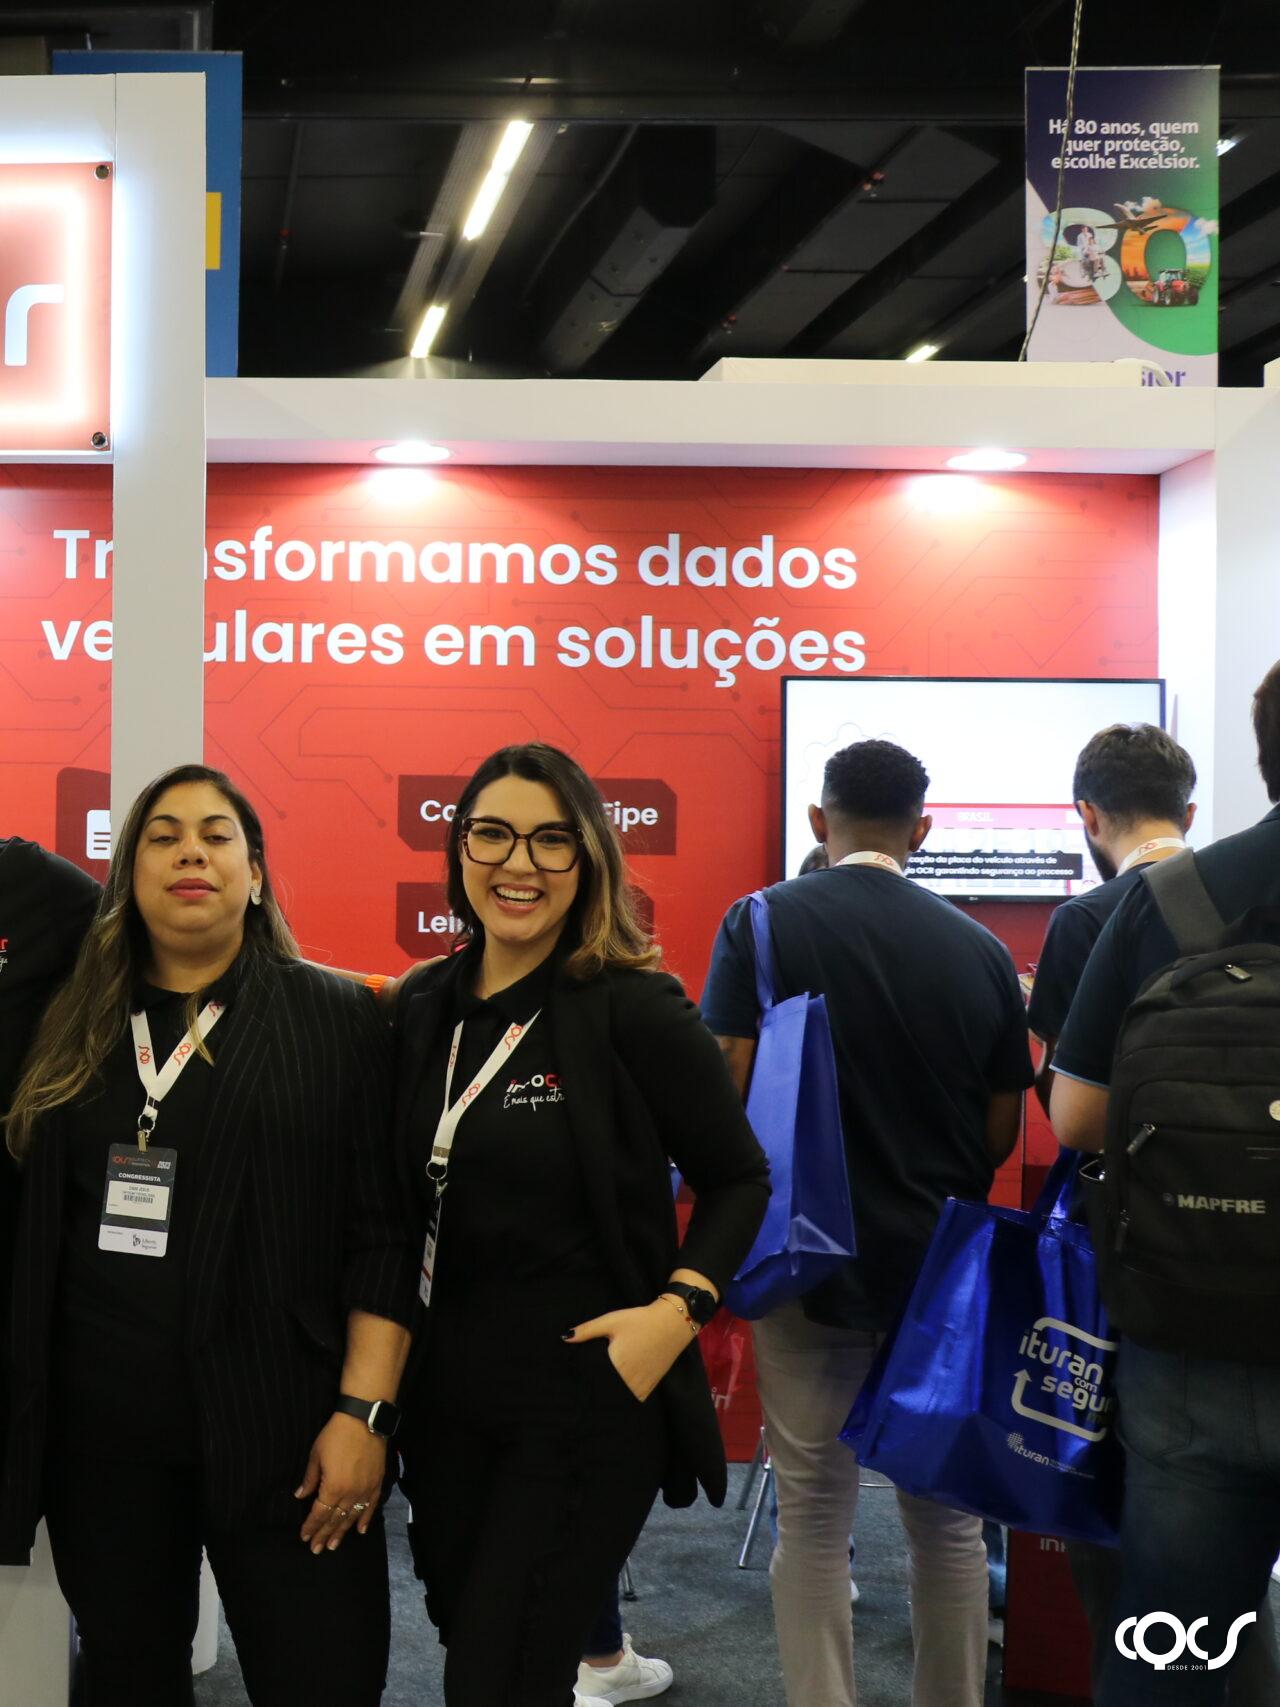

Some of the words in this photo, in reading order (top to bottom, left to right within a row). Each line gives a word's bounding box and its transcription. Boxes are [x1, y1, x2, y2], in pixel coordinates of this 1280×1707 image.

[1074, 119, 1097, 134] 80
[1100, 121, 1146, 137] anos,
[1149, 121, 1199, 138] quem
[1105, 136, 1186, 155] proteção,
[1051, 154, 1116, 169] escolhe
[1120, 154, 1200, 169] Excelsior.
[53, 525, 618, 587] Trsformamos
[637, 533, 857, 590] dados
[41, 609, 404, 664] veulares
[424, 621, 536, 666] em
[557, 615, 866, 688] soluções
[948, 856, 972, 865] placa
[935, 867, 980, 876] garantindo
[981, 868, 1024, 876] segurança
[118, 1172, 161, 1182] CONGRESSISTA
[1177, 1194, 1266, 1214] MAPFRE
[1019, 1331, 1103, 1384] ituran
[1074, 1377, 1097, 1393] com
